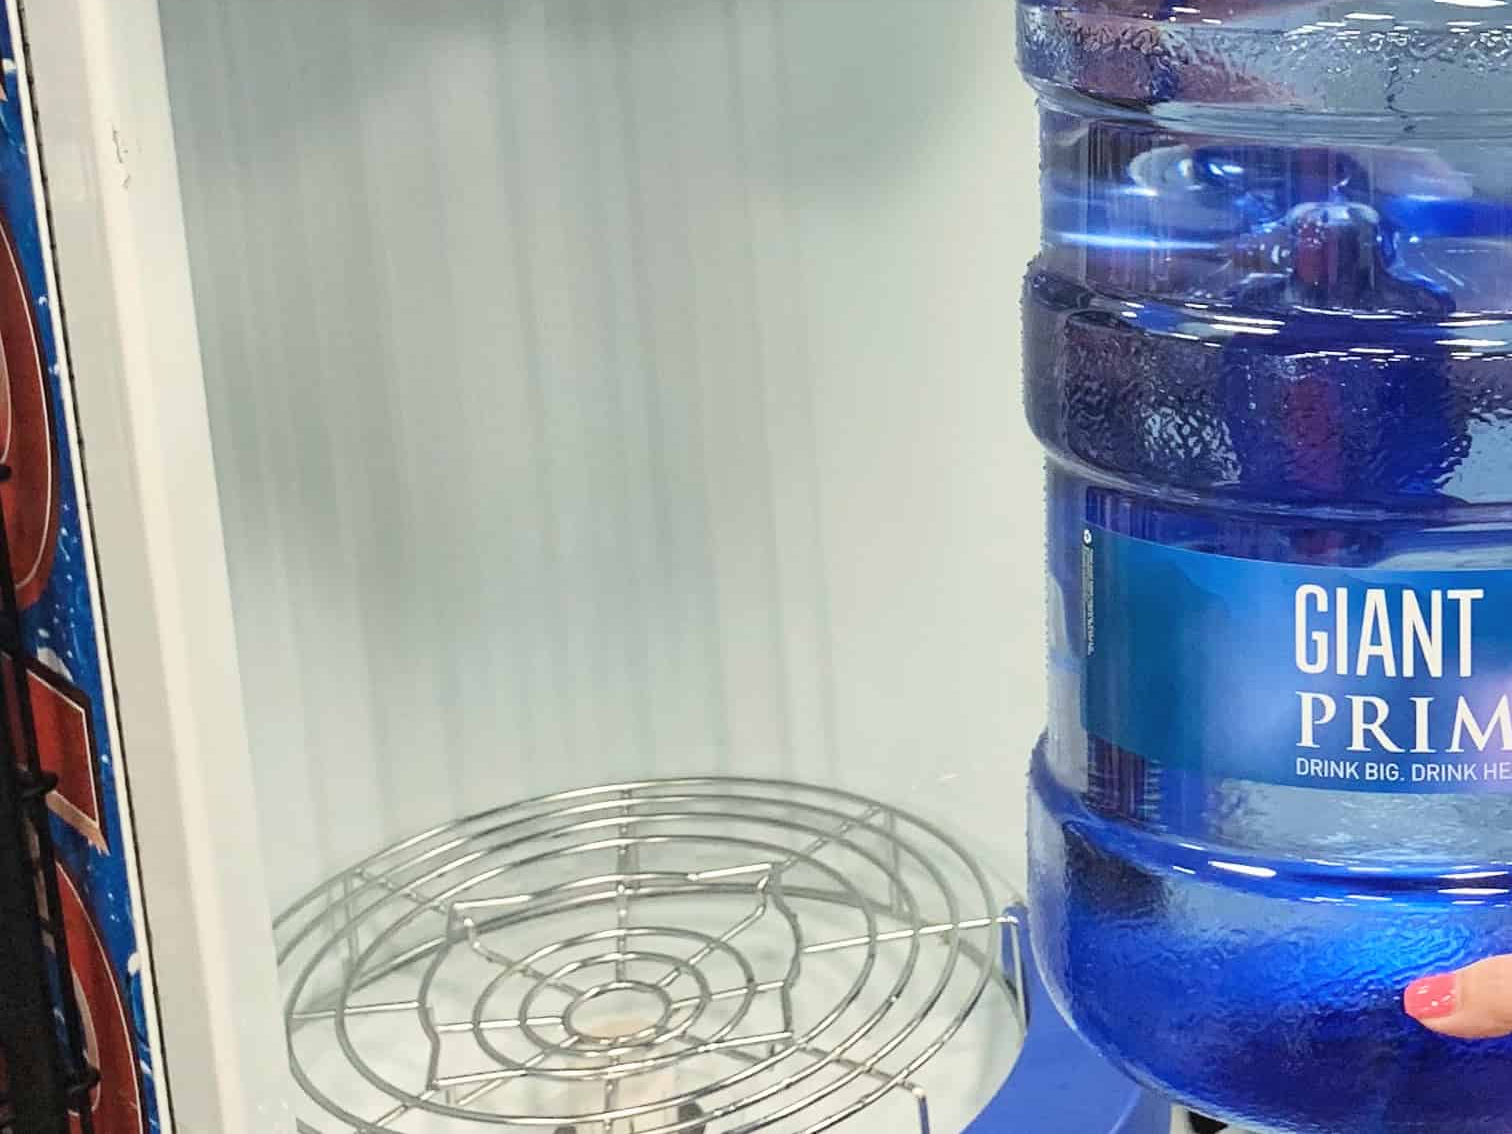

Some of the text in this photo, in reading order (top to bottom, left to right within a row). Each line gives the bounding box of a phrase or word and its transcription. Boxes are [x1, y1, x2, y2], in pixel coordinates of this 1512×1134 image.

[1295, 584, 1484, 678] GIANT
[1295, 757, 1360, 781] DRINK
[1365, 762, 1405, 782] BIG.
[1411, 763, 1478, 782] DRINK
